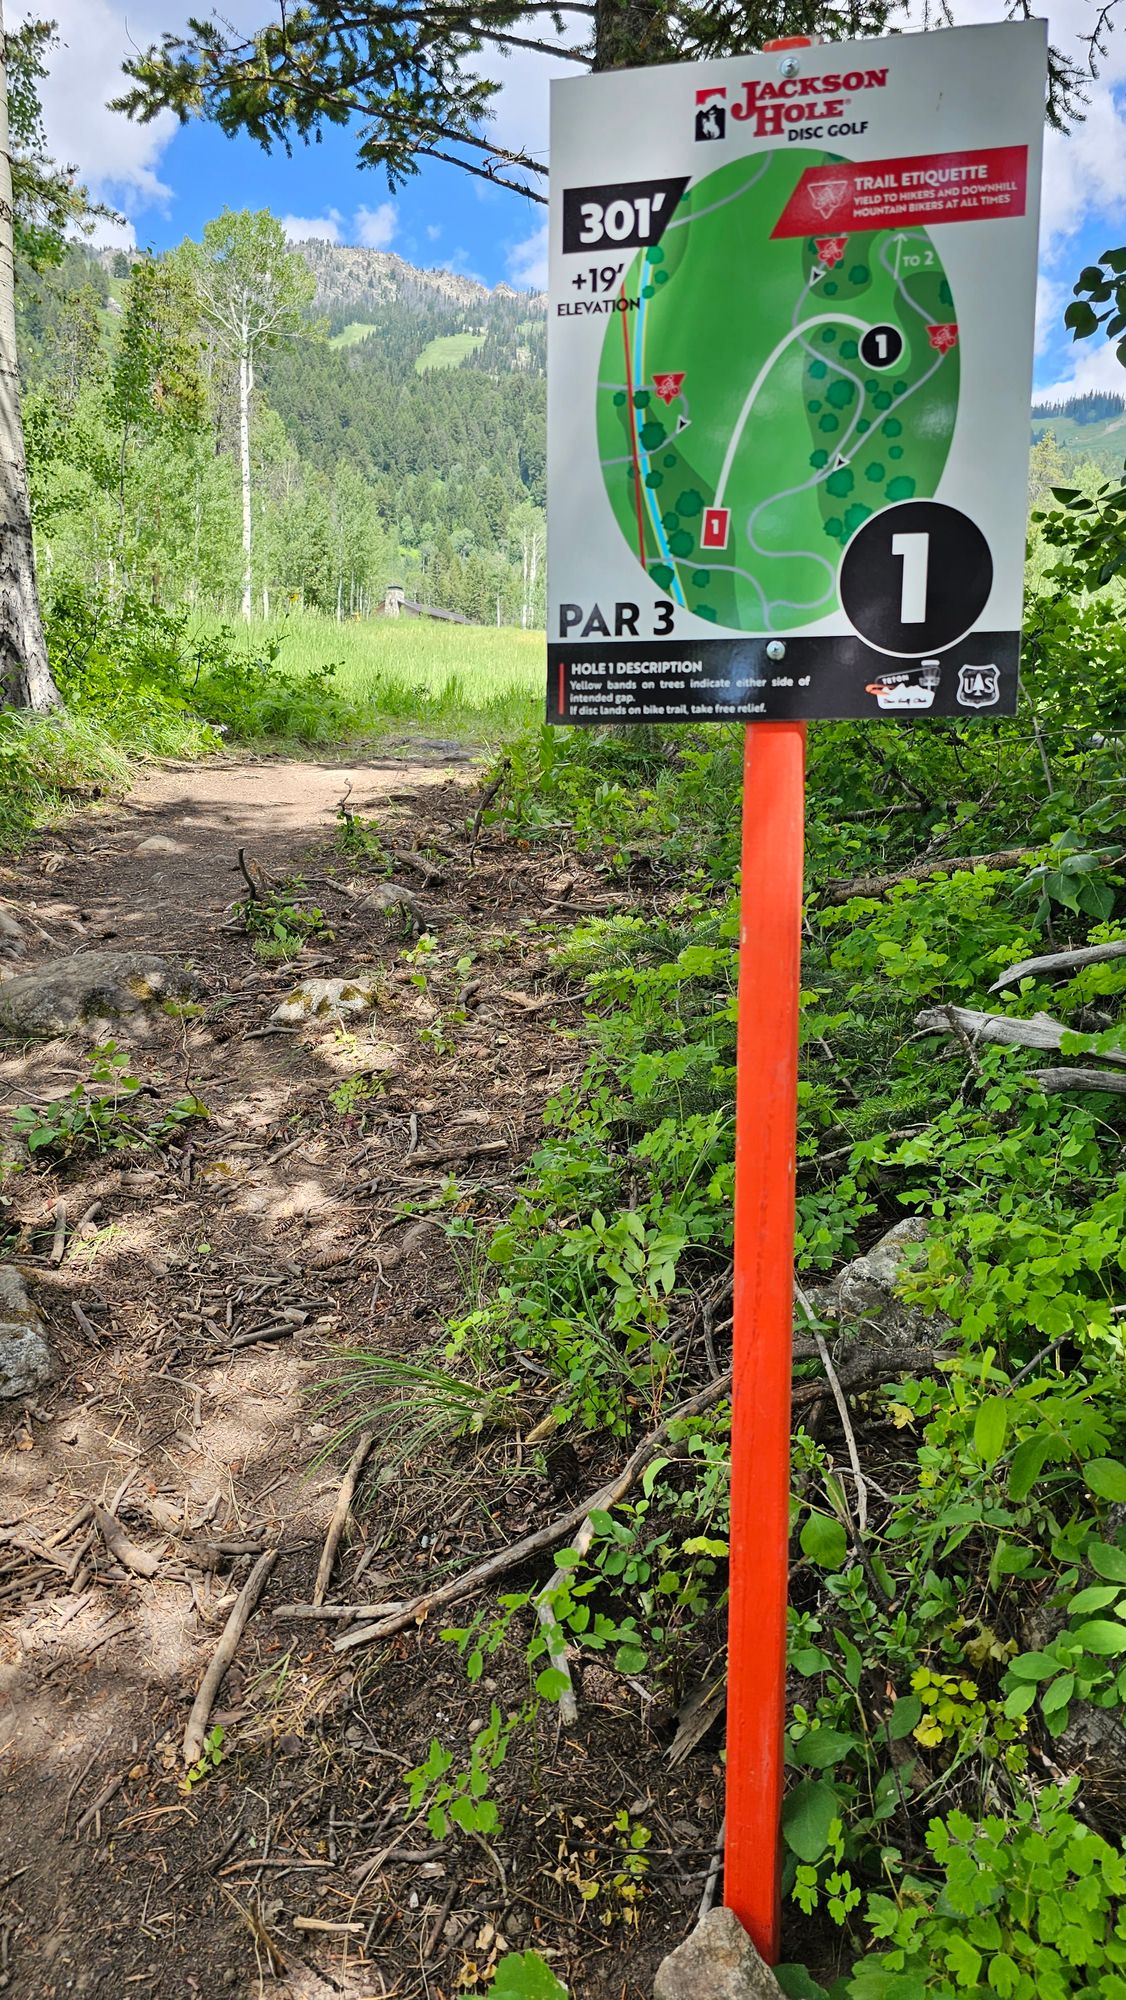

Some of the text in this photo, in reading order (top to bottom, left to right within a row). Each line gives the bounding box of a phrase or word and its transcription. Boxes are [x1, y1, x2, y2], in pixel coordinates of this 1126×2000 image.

[730, 68, 889, 122] JACKSON
[753, 99, 845, 137] HOLE
[788, 121, 869, 142] DISC GOLF
[854, 165, 988, 191] TRAIL ETIQUETTE
[854, 181, 1018, 206] YIELD TO HIKERS AND DOWNHILL
[853, 194, 1011, 218] MOUNTAIN BIKERS AT ALL TIMES
[903, 251, 934, 267] TO 2
[557, 297, 641, 317] ELEVATION
[875, 334, 888, 359] 1
[711, 518, 719, 535] 1
[891, 532, 930, 624] 1
[559, 600, 675, 638] PAR 3
[571, 660, 702, 675] HOLE 1 DESCRIPTION
[569, 675, 811, 690] Yellow bands on trees indicate either side of
[569, 693, 636, 705] intended gap.
[569, 703, 767, 716] If disc lands on bike trail, take free relief.
